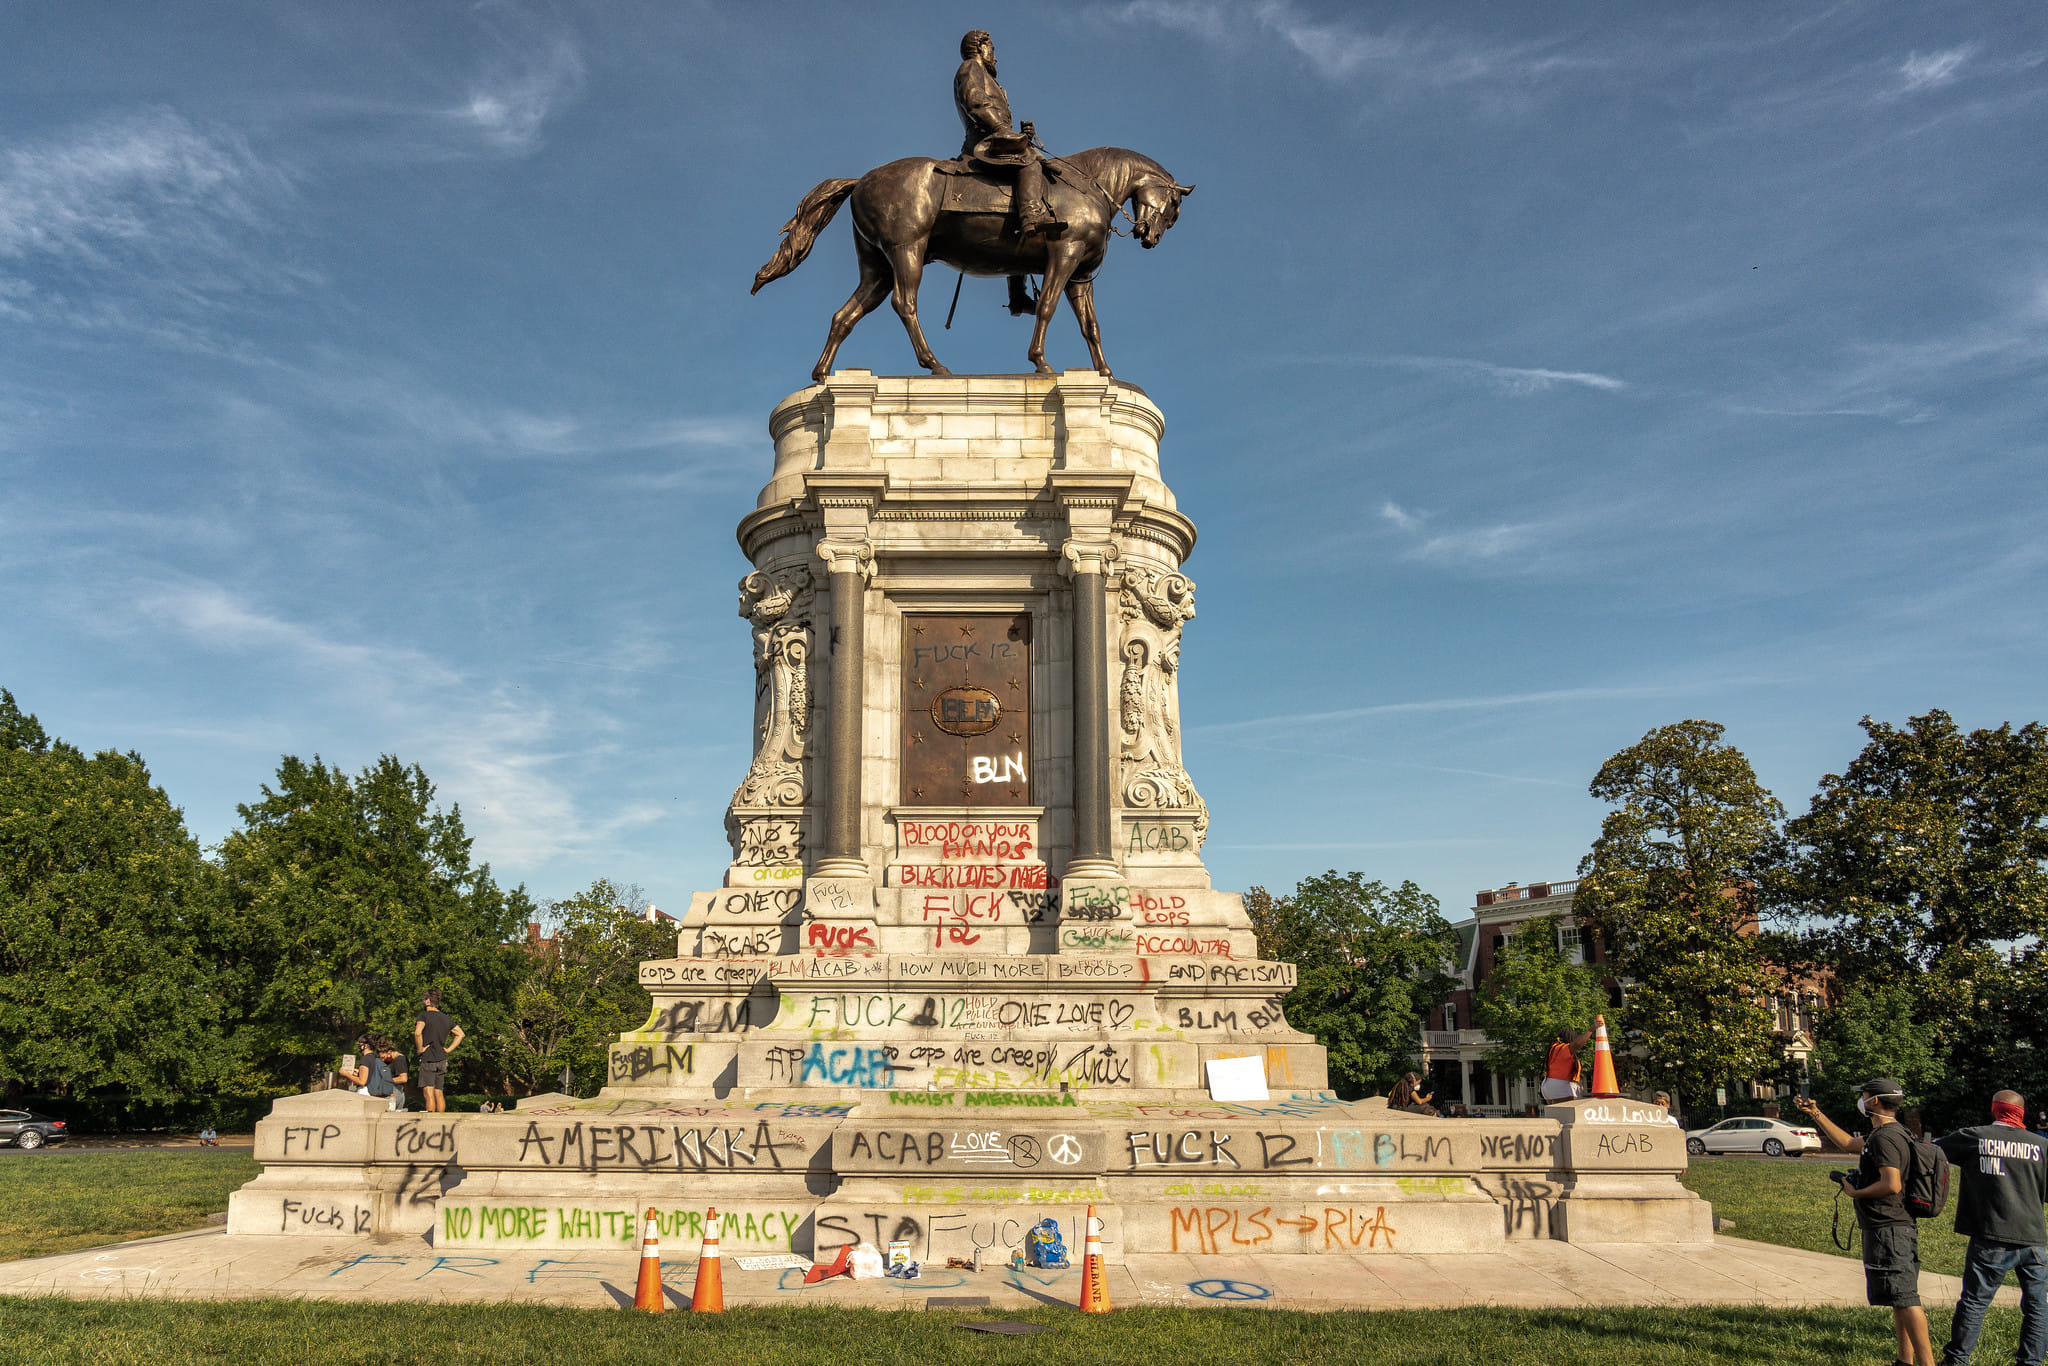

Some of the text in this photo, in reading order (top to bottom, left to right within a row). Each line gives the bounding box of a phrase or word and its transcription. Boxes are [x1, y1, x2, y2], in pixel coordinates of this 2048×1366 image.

[912, 642, 1017, 668] FUCK 12
[973, 751, 1027, 784] BLM
[903, 822, 960, 847] BLOOD
[1128, 822, 1188, 857] ACAB
[943, 839, 1033, 859] HANDS
[726, 890, 775, 914] ONE
[923, 892, 1004, 921] FUCK
[1007, 890, 1059, 912] FUCK
[1129, 894, 1186, 912] HOLD
[1022, 908, 1045, 923] 12
[1145, 912, 1190, 927] COPS
[715, 931, 770, 958] ACAB
[809, 923, 875, 948] FUCK
[935, 916, 981, 948] 12
[681, 967, 706, 982] are
[811, 957, 858, 977] ACAB
[900, 962, 933, 976] HOW
[940, 961, 987, 977] MUCH
[993, 961, 1044, 977] MORE
[1059, 963, 1134, 978] BLOOD?
[1169, 964, 1293, 985] END RACISM!
[808, 995, 975, 1028] FUCK 12
[965, 996, 998, 1010] HOLD
[966, 1009, 999, 1020] POLICE
[998, 1001, 1052, 1028] ONE
[1056, 1002, 1105, 1028] LOVE
[1179, 1007, 1238, 1030] BLM
[801, 1043, 895, 1088] ACAB
[953, 1047, 985, 1066] are
[889, 1092, 955, 1106] RACIST
[964, 1091, 1078, 1107] AMERIKKKA
[284, 1124, 341, 1155] FTP
[518, 1120, 805, 1177] AMERIKKKA
[850, 1132, 1002, 1165] ACAB LOVE
[1125, 1130, 1241, 1169] FUCK
[1373, 1133, 1454, 1166] BLM
[1597, 1132, 1653, 1157] ACAB
[1979, 1138, 2041, 1162] RICHMOND'S
[353, 1205, 371, 1234] 12
[445, 1206, 799, 1252] NO MORE WHITE UPRMACY
[1170, 1207, 1273, 1255] MPLS
[1088, 1253, 1102, 1303] GILBANE
